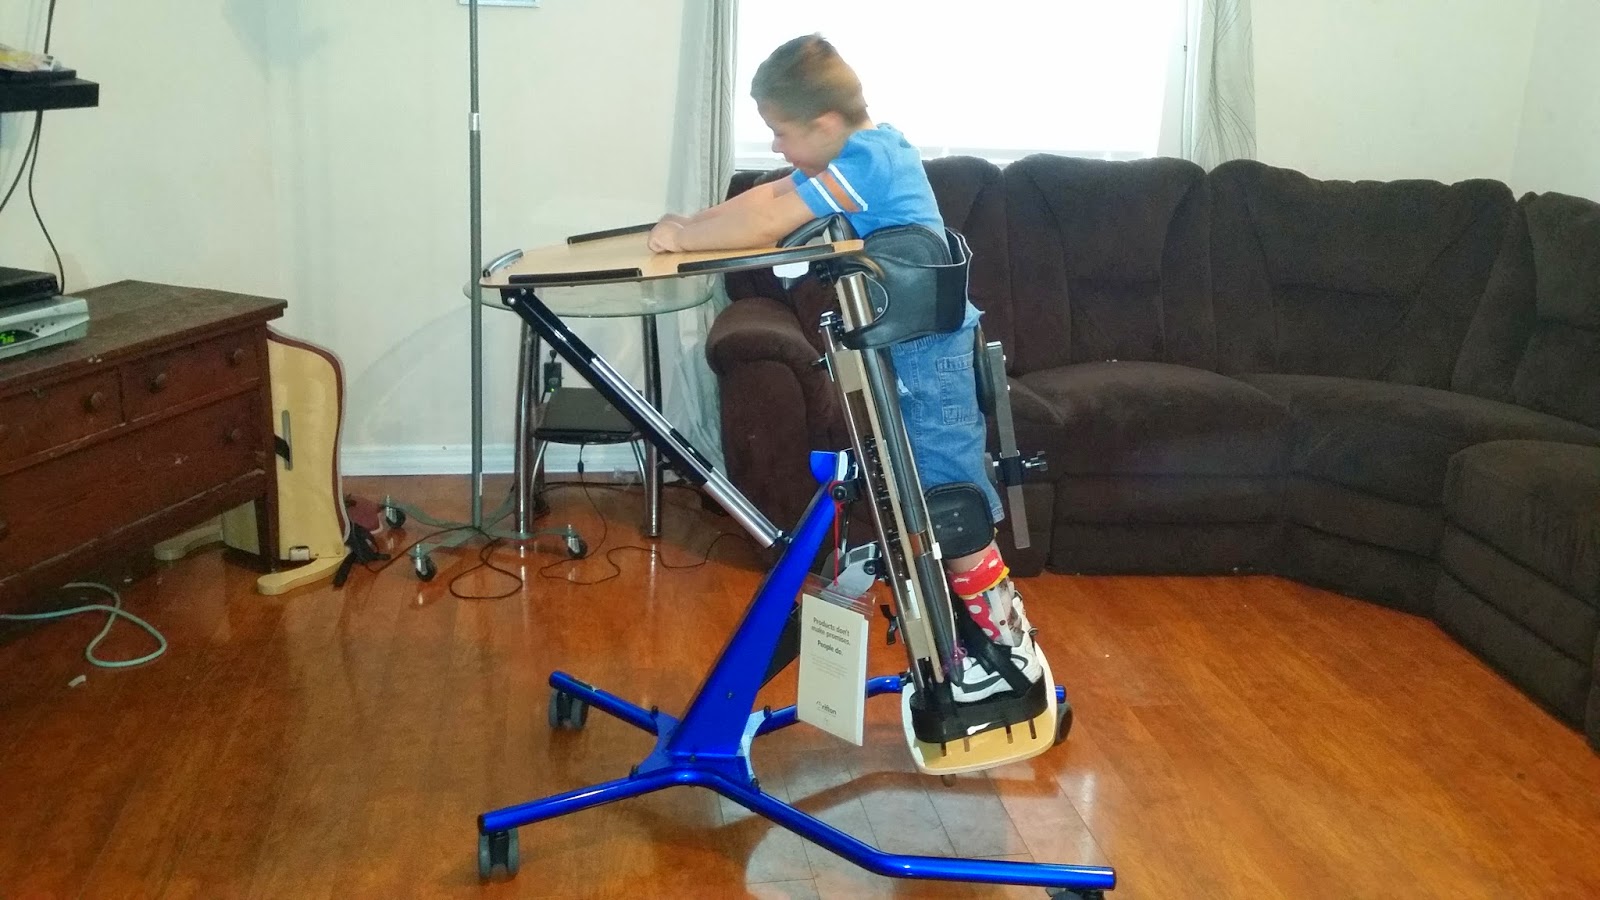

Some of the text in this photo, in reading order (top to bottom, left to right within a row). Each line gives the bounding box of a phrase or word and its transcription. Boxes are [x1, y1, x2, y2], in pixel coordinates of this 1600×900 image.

[811, 625, 825, 635] make
[813, 616, 850, 637] Products don't
[817, 639, 834, 652] People
